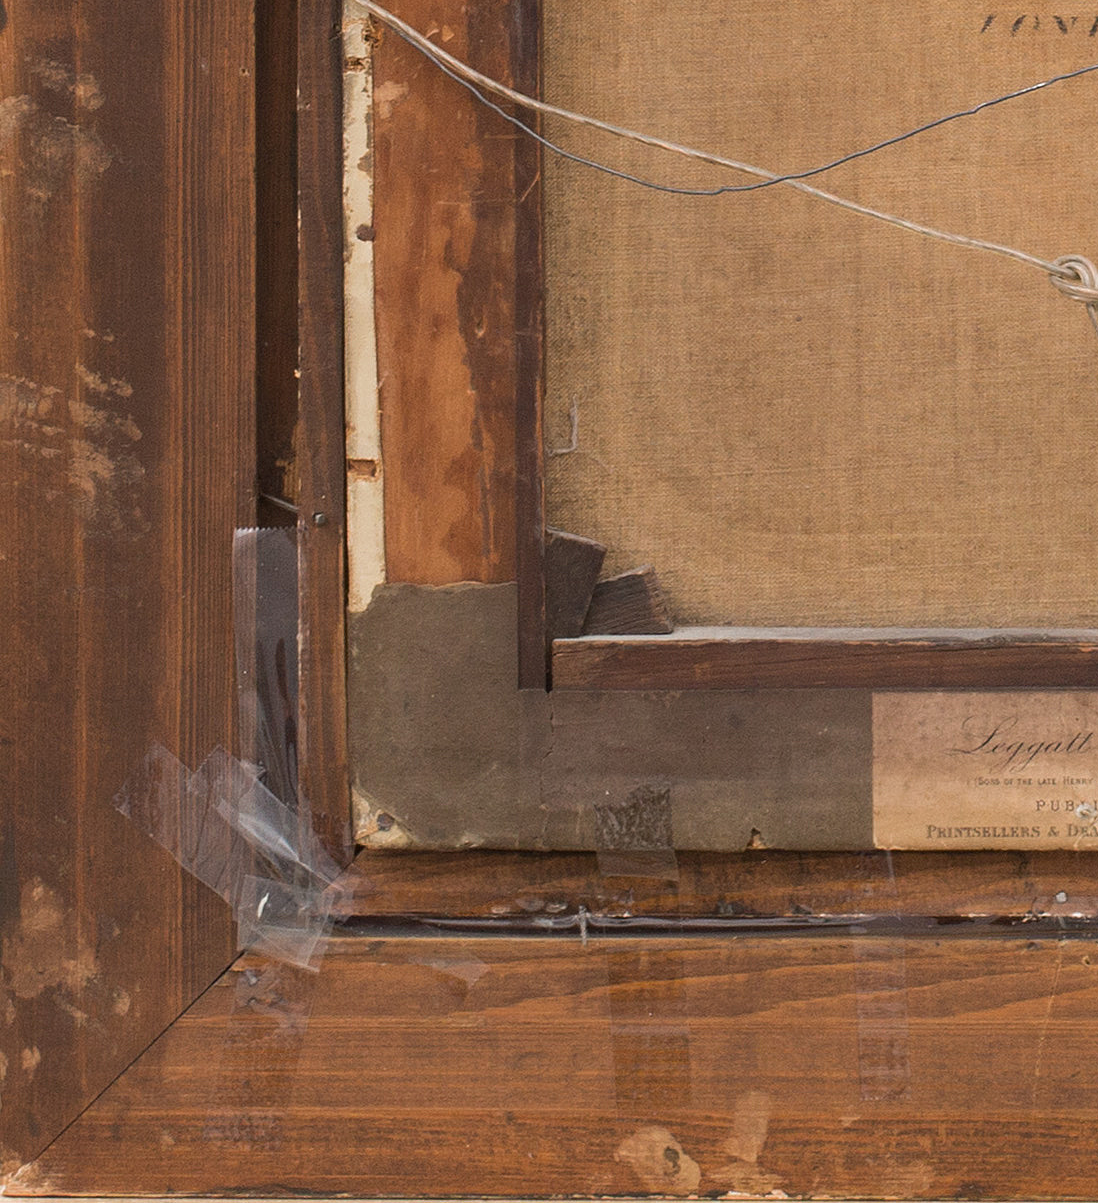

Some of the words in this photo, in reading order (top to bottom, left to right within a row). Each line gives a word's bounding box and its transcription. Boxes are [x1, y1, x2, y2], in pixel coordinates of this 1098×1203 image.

[944, 715, 1094, 773] Leggatt
[926, 823, 1041, 839] PRINTSELLERS
[1046, 825, 1061, 838] &
